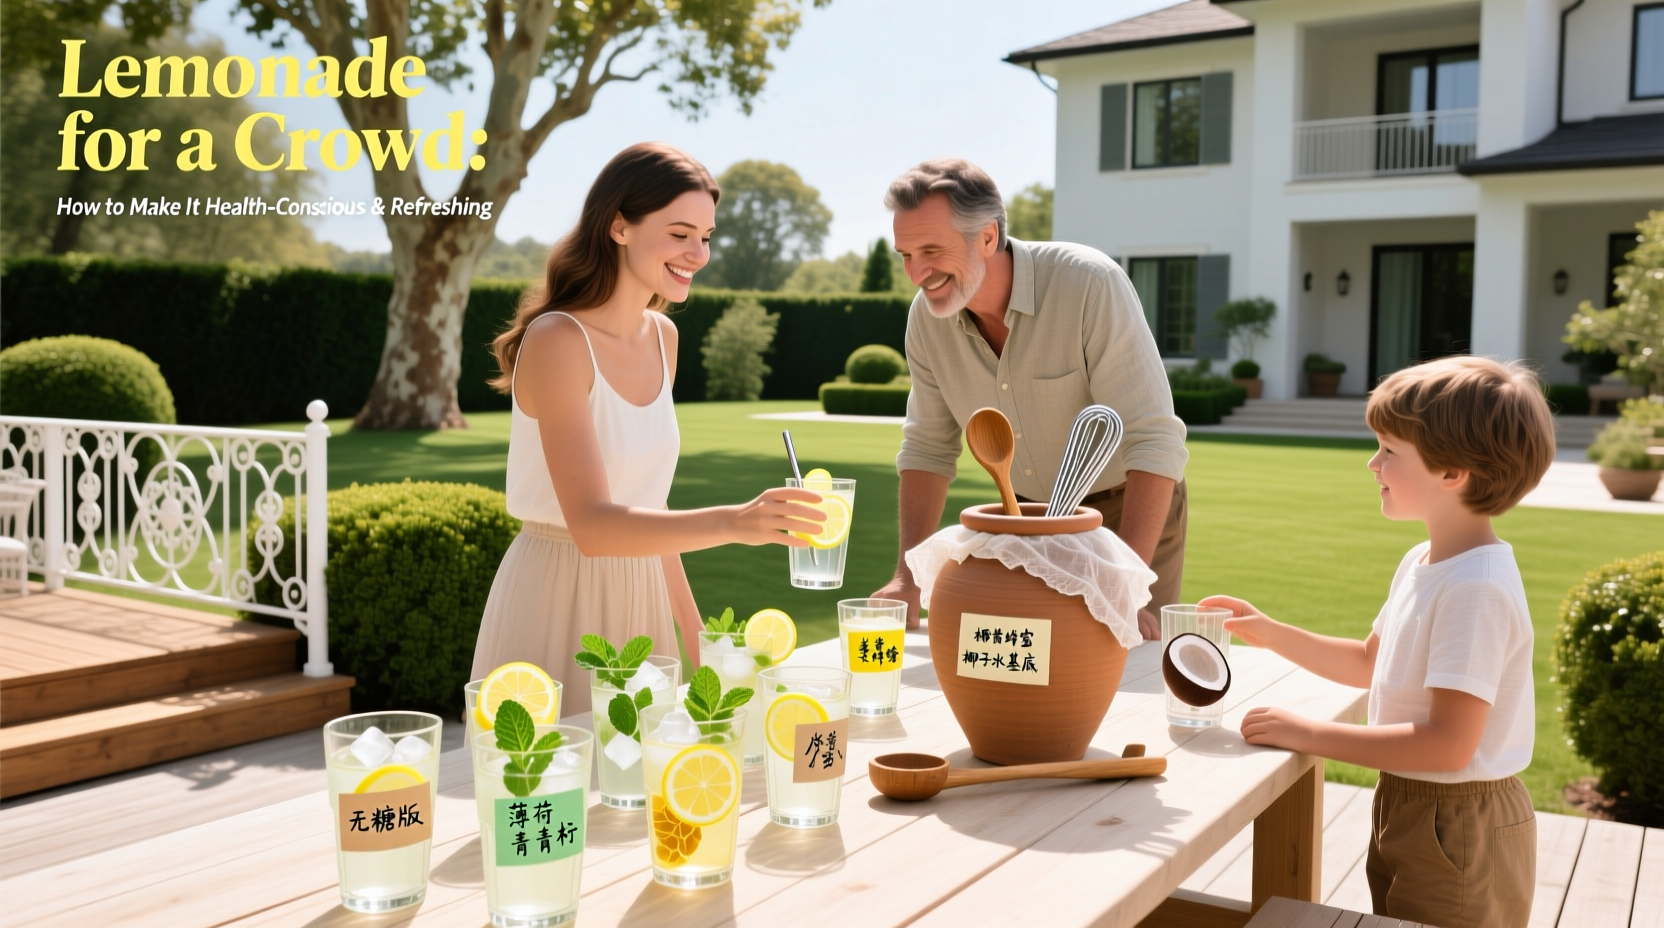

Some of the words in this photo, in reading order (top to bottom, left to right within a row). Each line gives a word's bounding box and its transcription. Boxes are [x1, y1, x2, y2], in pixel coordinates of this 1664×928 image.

[348, 803, 424, 833] 无糖版
[508, 800, 553, 829] 薄荷
